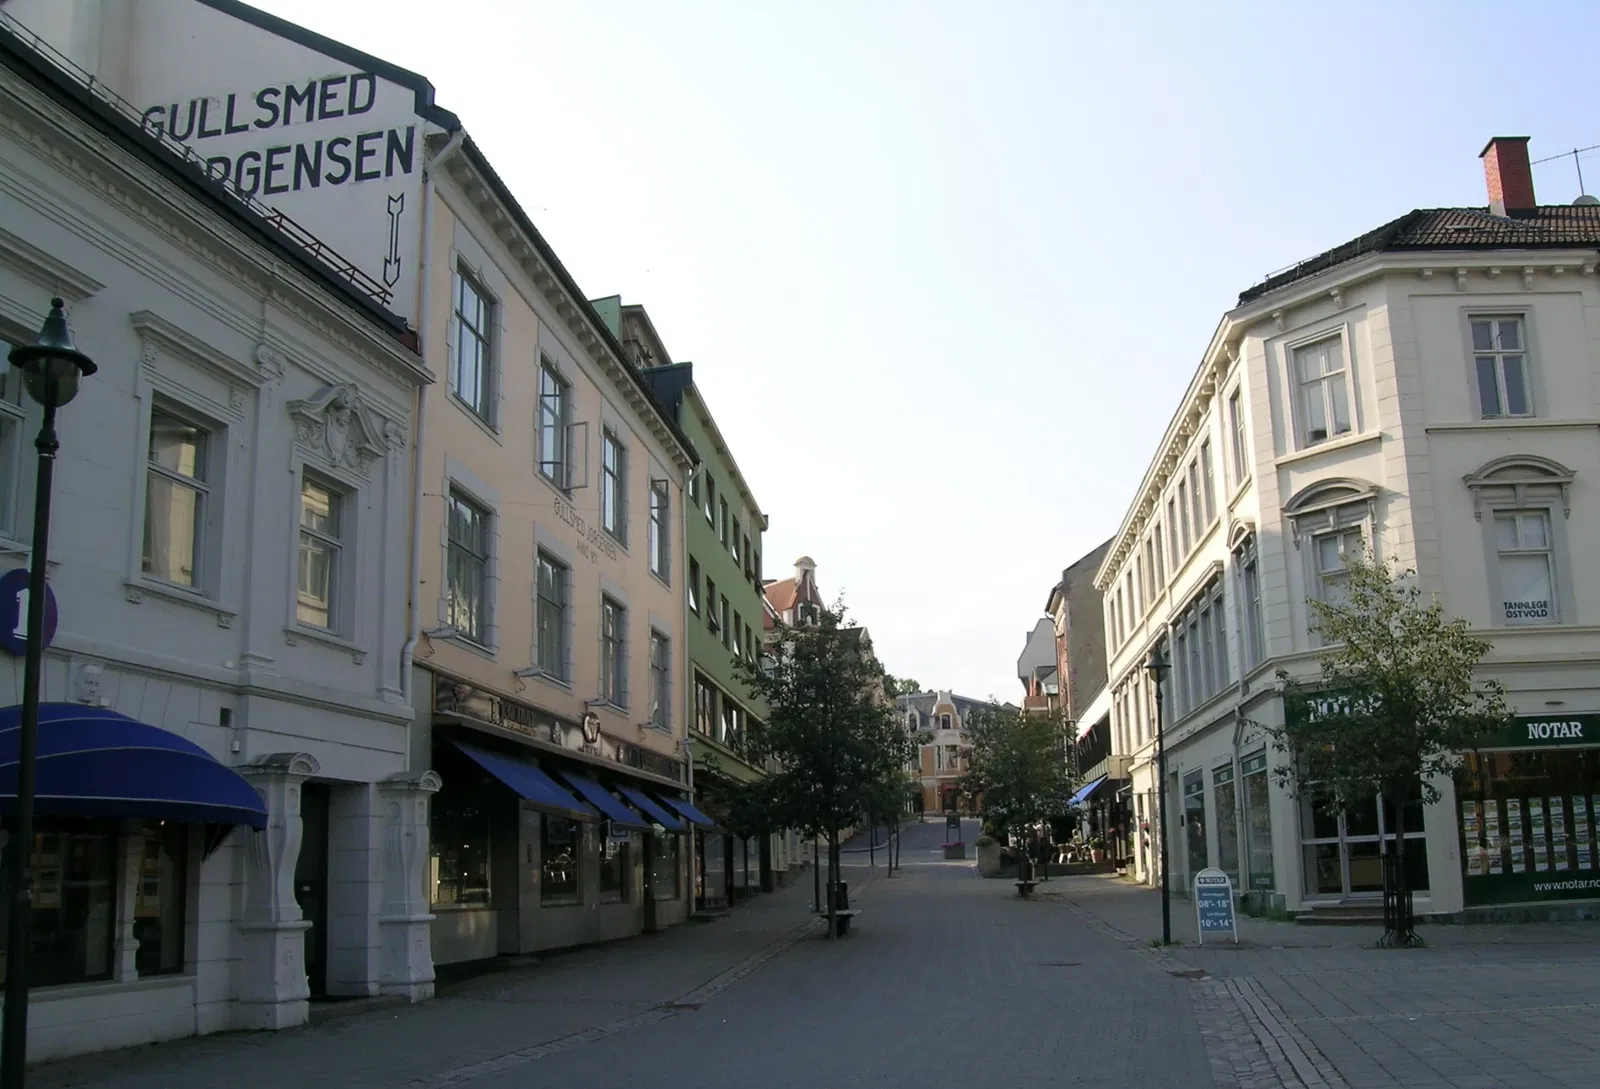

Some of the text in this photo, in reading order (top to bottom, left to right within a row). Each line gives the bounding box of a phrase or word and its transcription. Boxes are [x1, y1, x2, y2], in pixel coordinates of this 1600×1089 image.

[140, 73, 377, 142] GULLSMED
[1503, 601, 1548, 610] TANNLEGE
[1527, 721, 1583, 740] NOTAR
